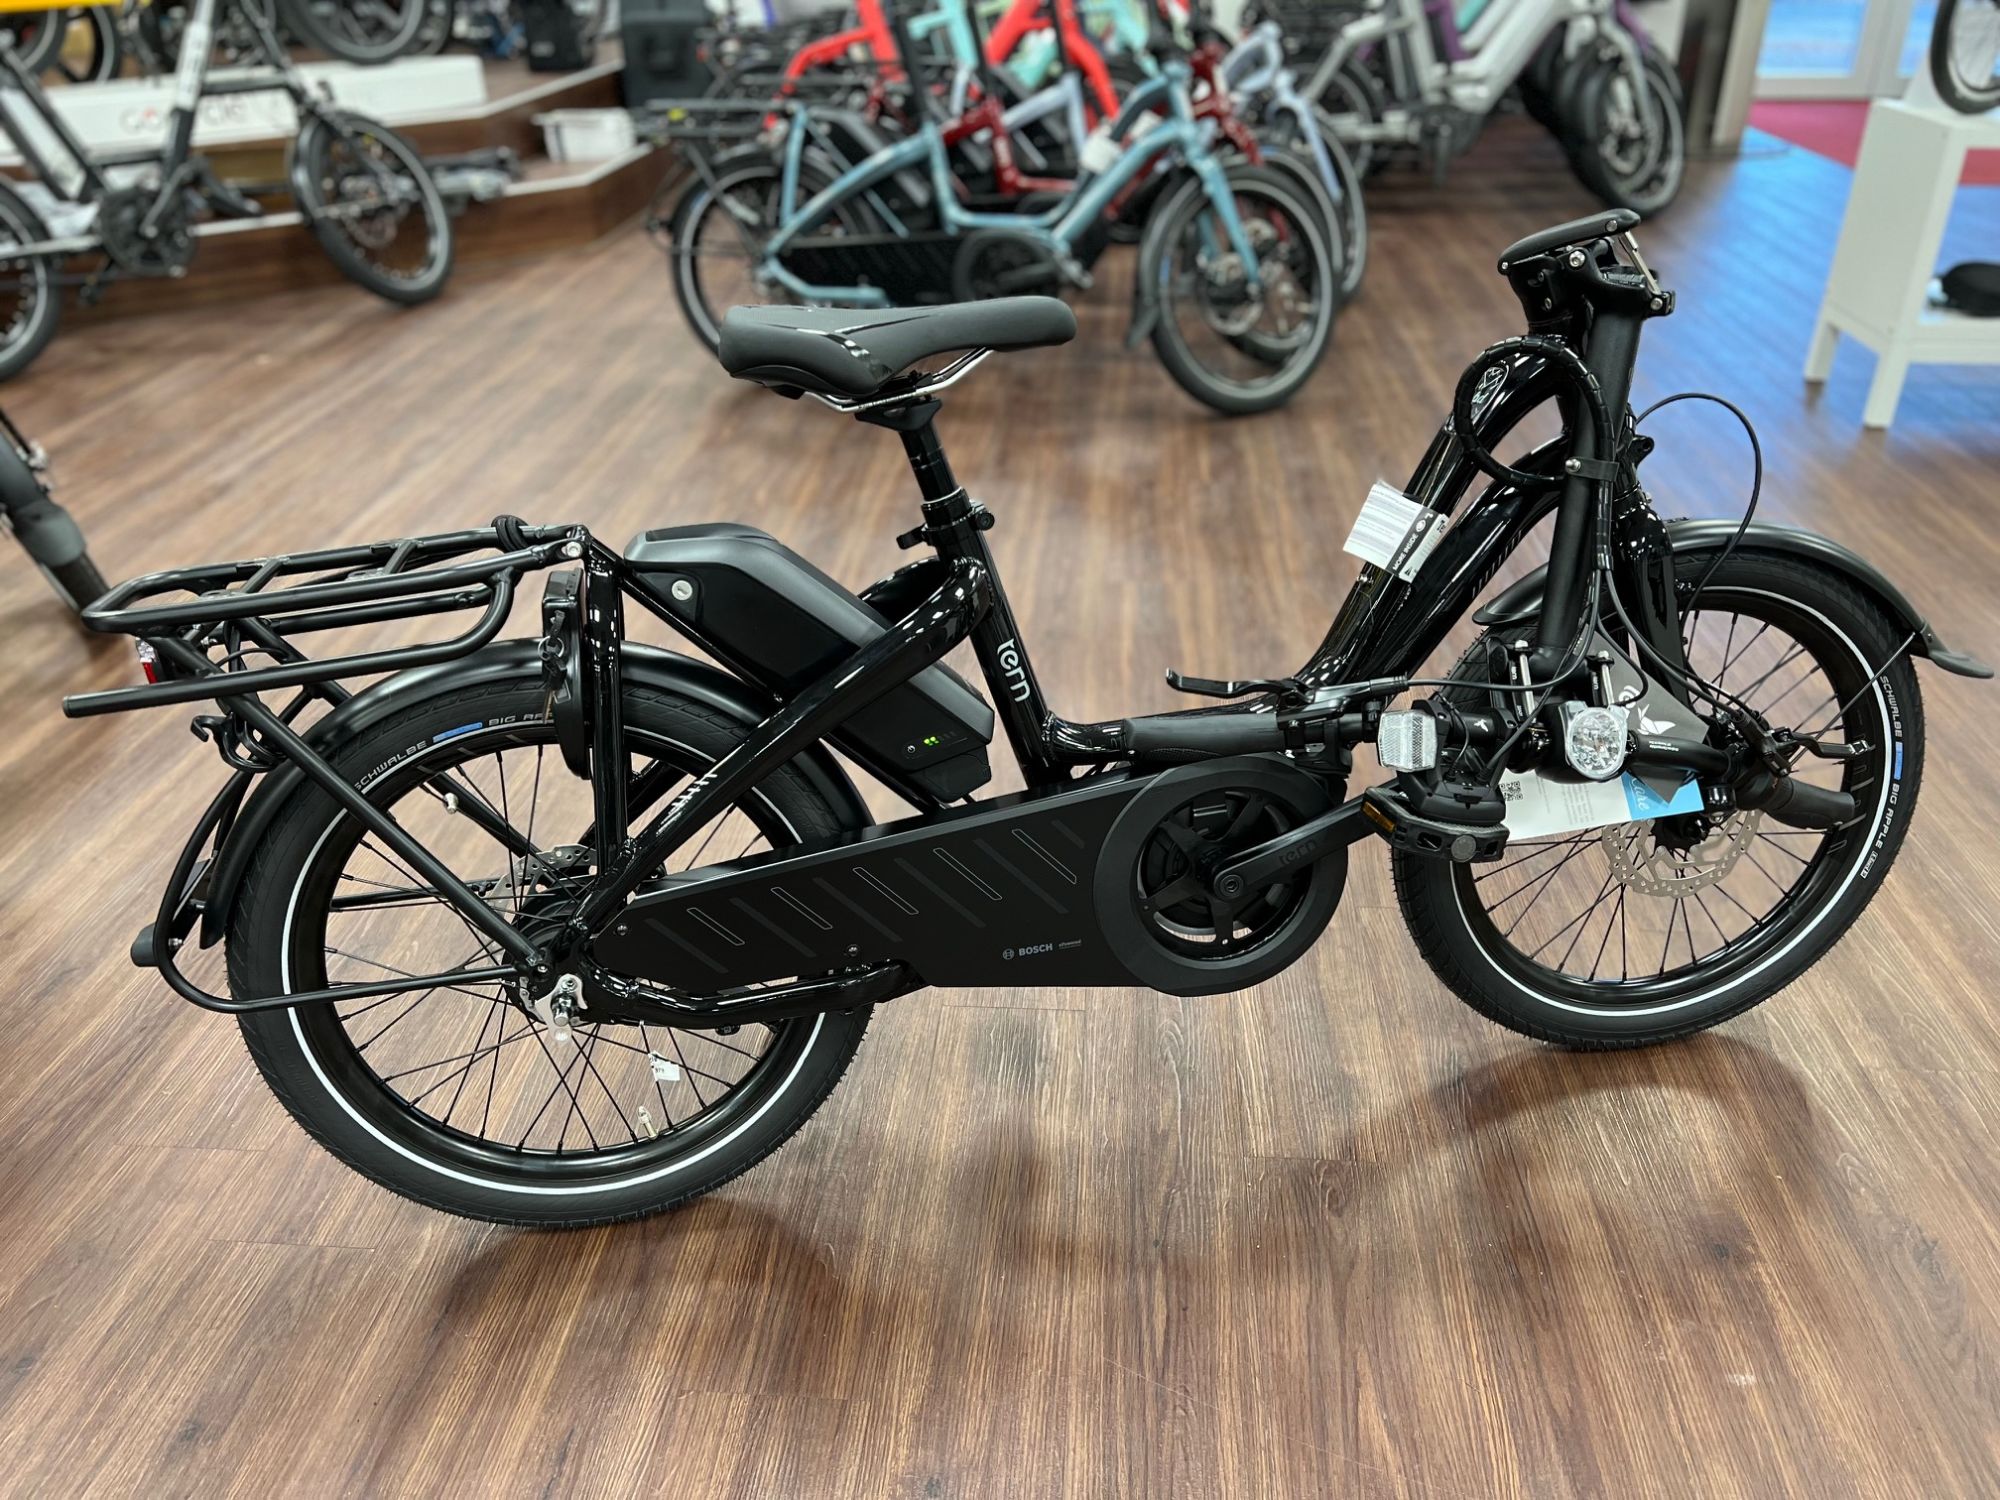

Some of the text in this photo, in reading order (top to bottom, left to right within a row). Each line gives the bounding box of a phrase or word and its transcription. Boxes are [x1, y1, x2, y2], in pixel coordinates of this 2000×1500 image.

[997, 638, 1031, 702] tern
[488, 715, 516, 726] BIG
[1880, 675, 1903, 738] SCHWALBE
[354, 740, 428, 790] SCHWALBE
[1875, 783, 1900, 849] BIG APPLE
[1018, 943, 1053, 957] BOSCH
